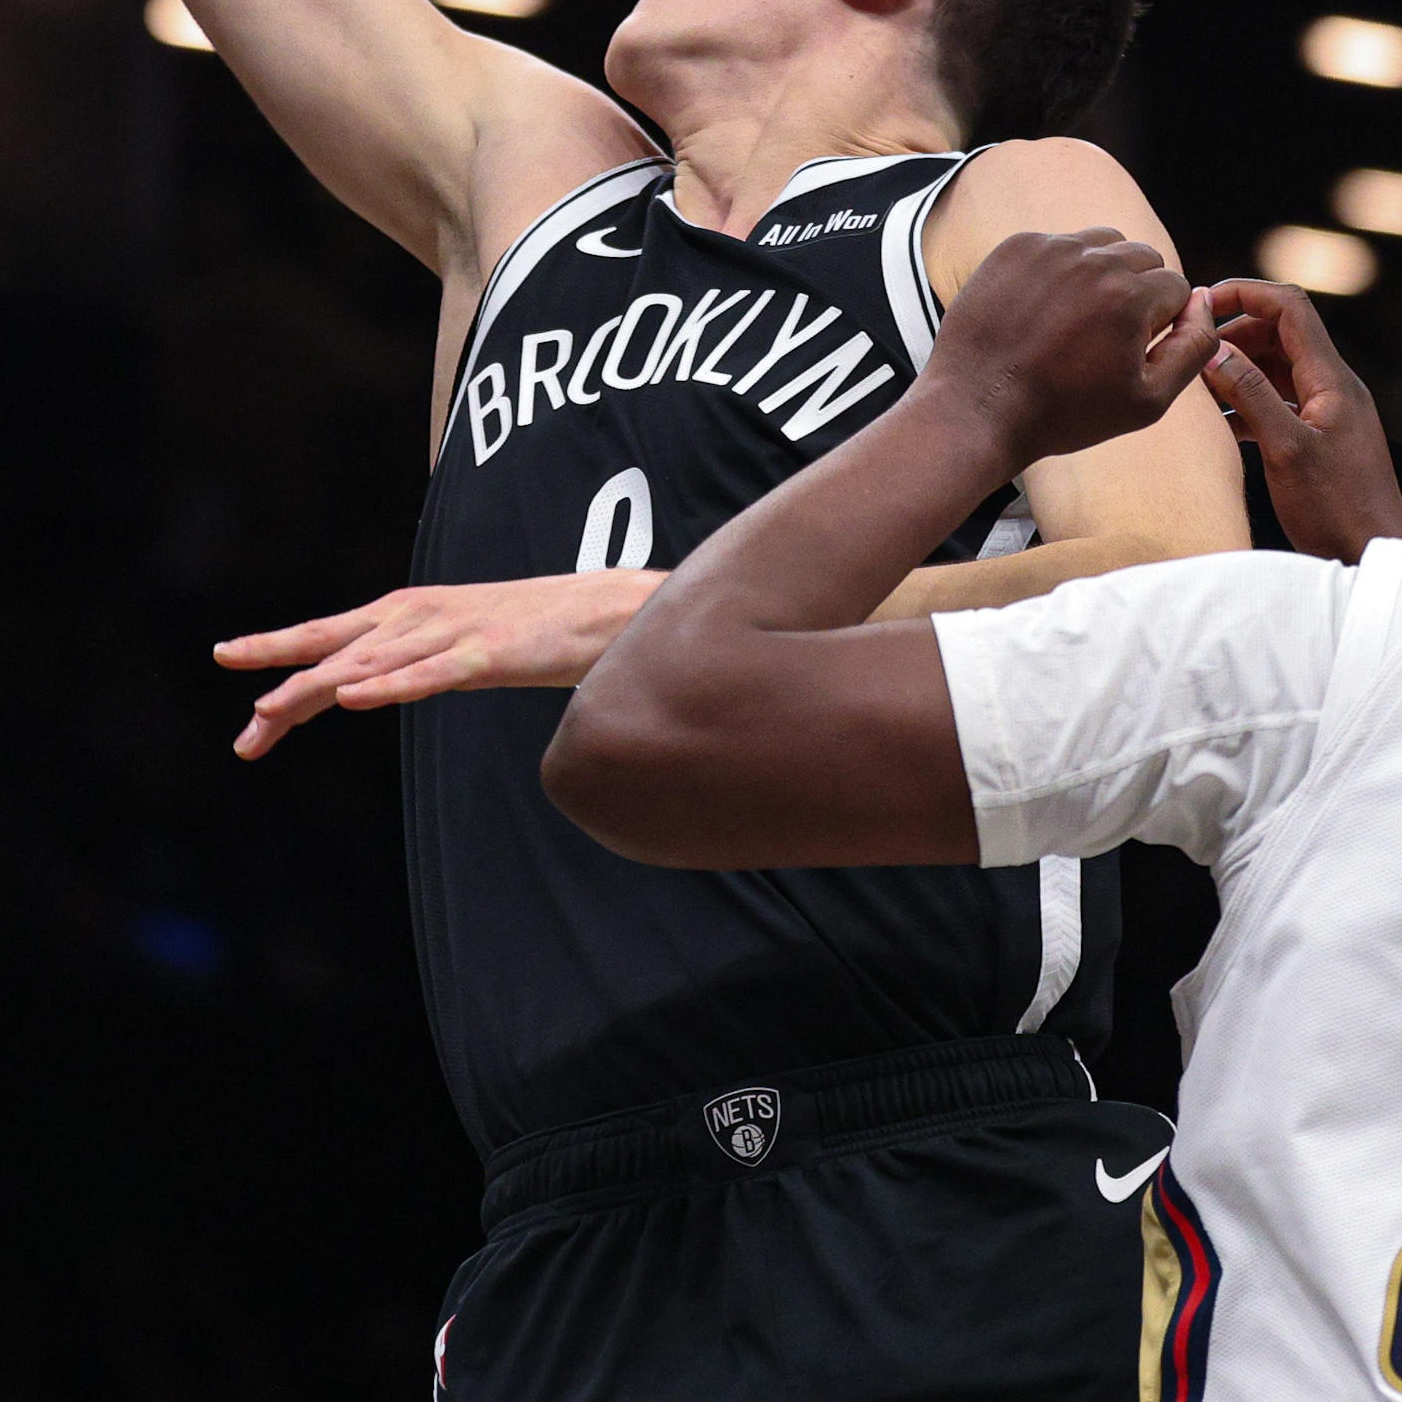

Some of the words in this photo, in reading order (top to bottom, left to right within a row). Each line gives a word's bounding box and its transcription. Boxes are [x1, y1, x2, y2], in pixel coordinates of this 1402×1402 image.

[758, 223, 801, 247] All
[796, 222, 824, 243] In
[823, 208, 878, 234] Won
[467, 288, 895, 467] BROOKLYN
[712, 1094, 774, 1133] NETS
